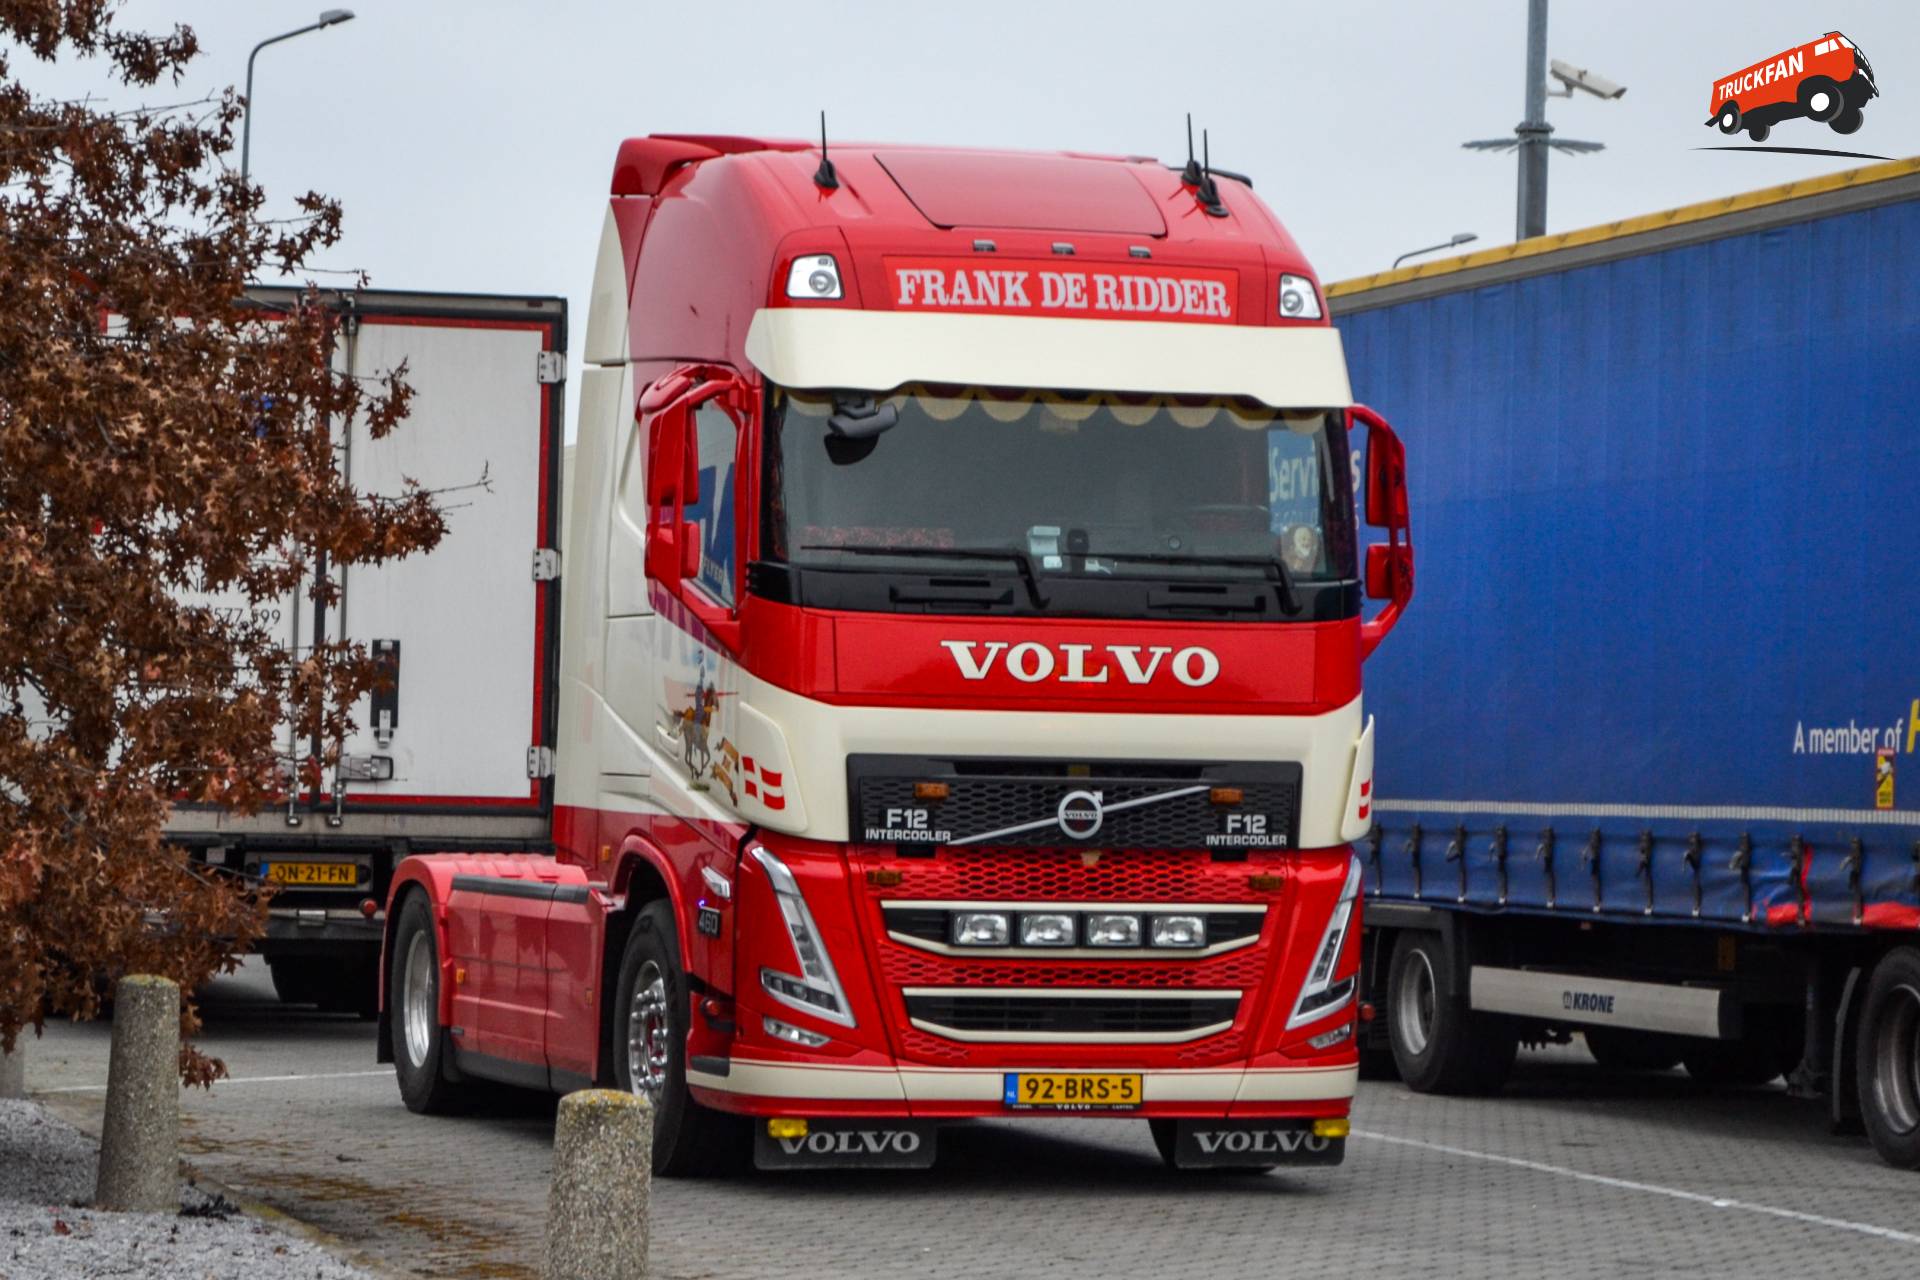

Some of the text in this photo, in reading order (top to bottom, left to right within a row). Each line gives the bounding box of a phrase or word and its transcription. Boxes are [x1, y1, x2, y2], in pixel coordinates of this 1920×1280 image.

[896, 268, 1231, 318] FRANK DE RIDDER
[941, 640, 1220, 687] VOLVO
[1793, 720, 1805, 753] A
[1809, 719, 1879, 753] member
[1884, 718, 1904, 753] of
[886, 808, 928, 829] F12
[1227, 814, 1266, 834] F12
[865, 828, 951, 841] INTERCOOLER
[1206, 834, 1287, 846] INTERCOOLER
[698, 910, 719, 935] 460
[1573, 992, 1615, 1013] KRONE
[1026, 1078, 1133, 1099] 92-BRS-5
[779, 1131, 920, 1154] VOLVO
[1192, 1130, 1330, 1153] VOLVO
